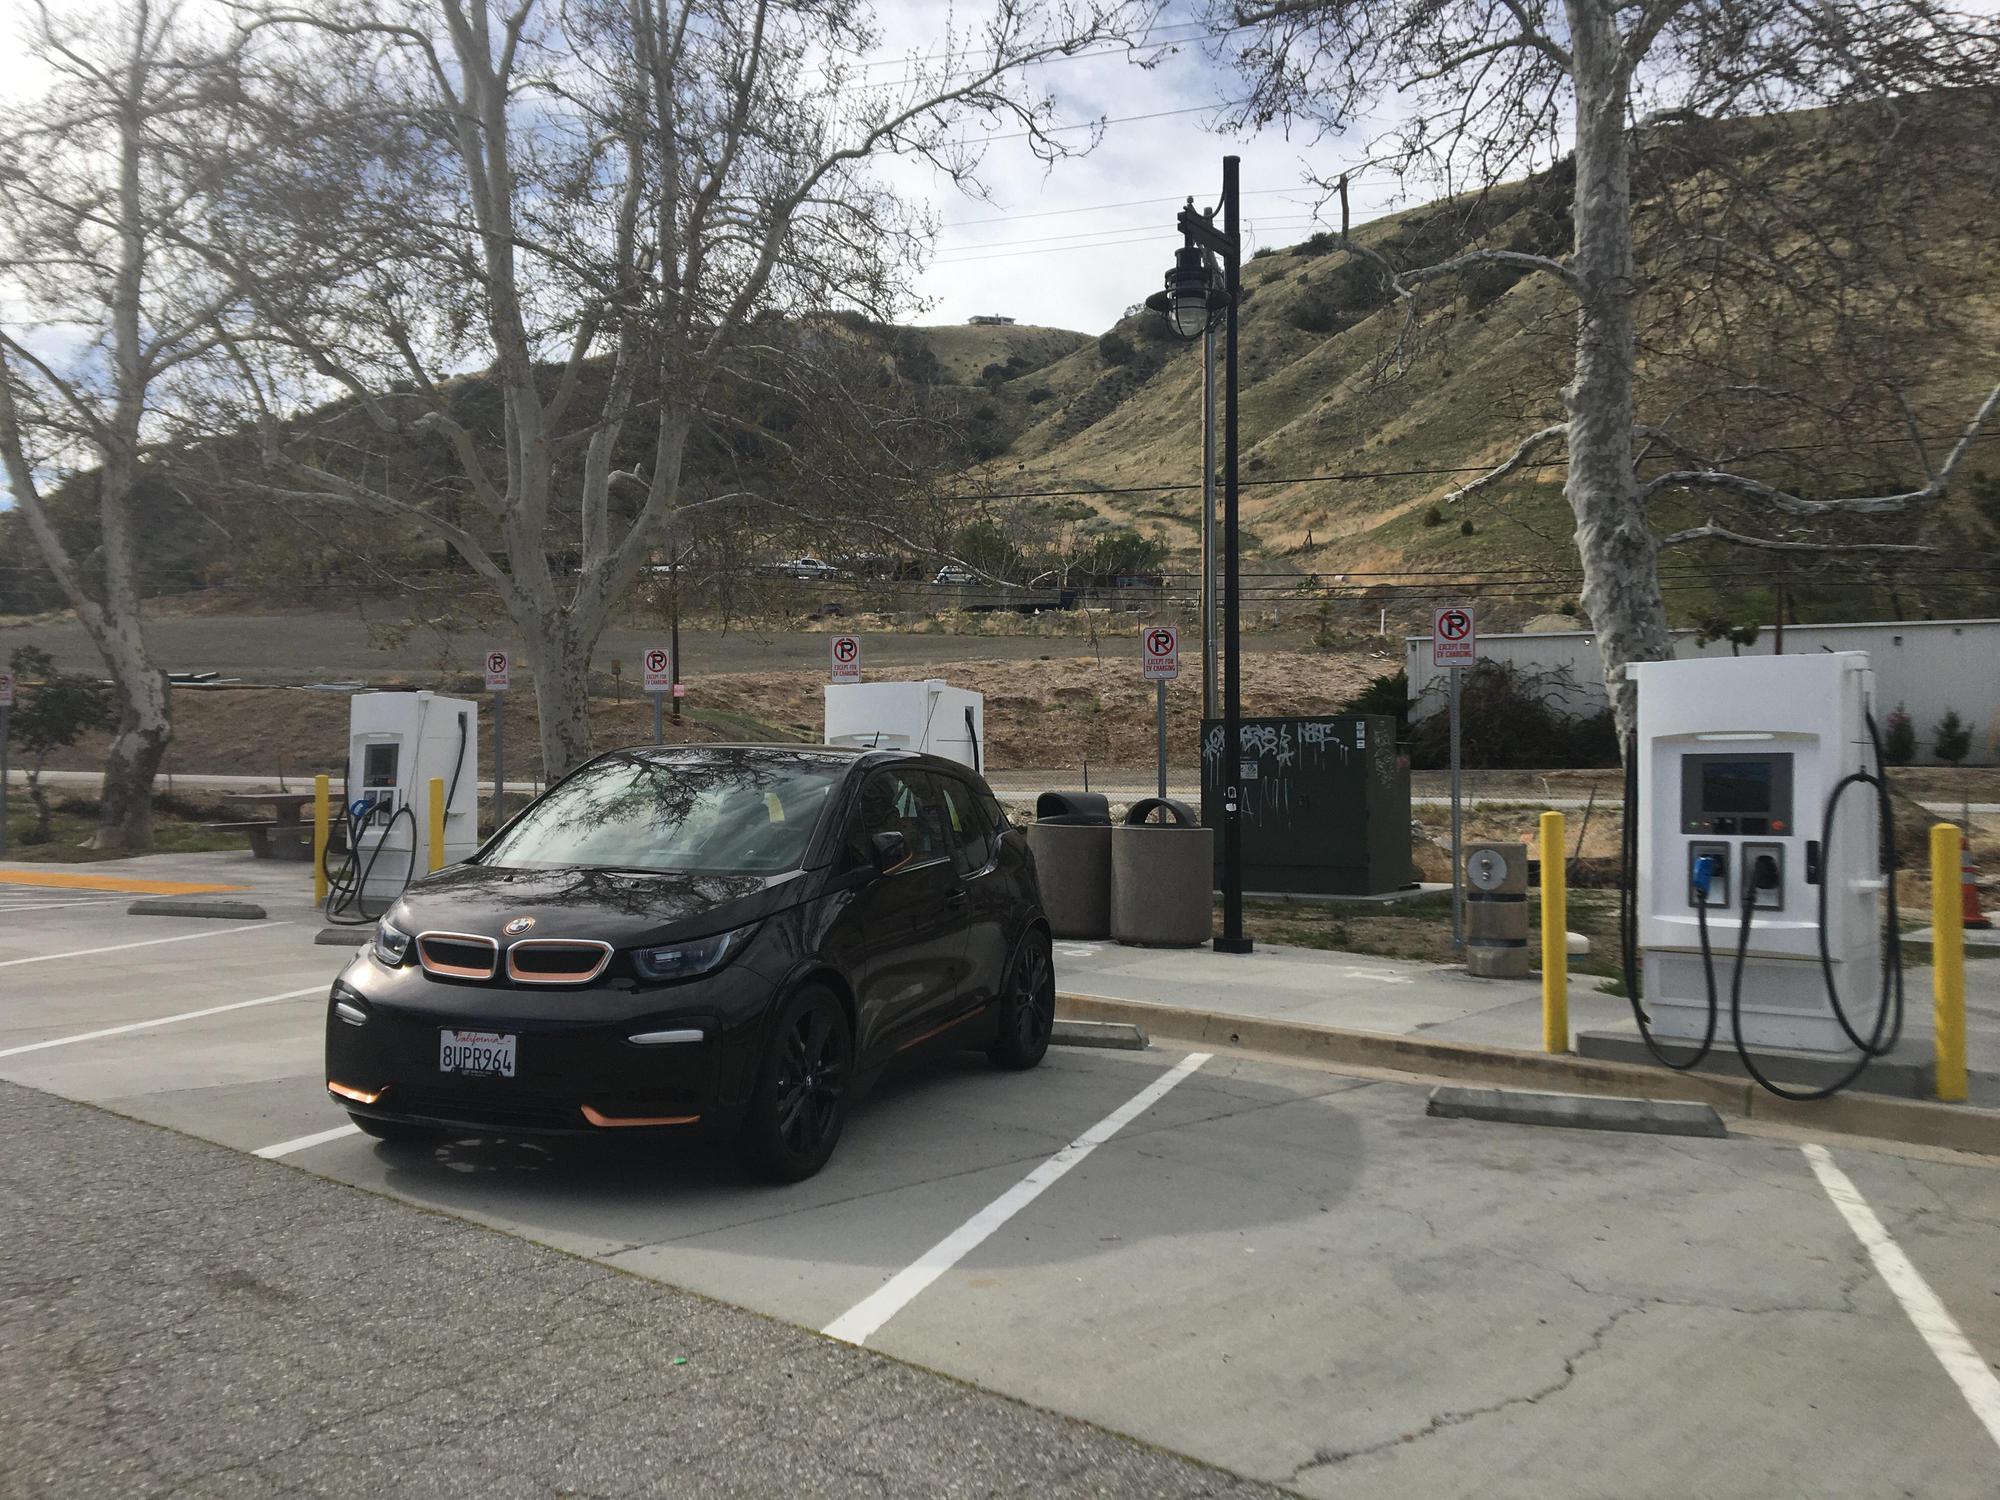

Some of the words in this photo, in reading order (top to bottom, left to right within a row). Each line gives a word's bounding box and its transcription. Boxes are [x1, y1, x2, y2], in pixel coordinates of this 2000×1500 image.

[1439, 643, 1457, 651] EXCEPT
[1445, 650, 1472, 658] CHARGING
[455, 1031, 499, 1046] California
[443, 1045, 512, 1072] 8UPR964
